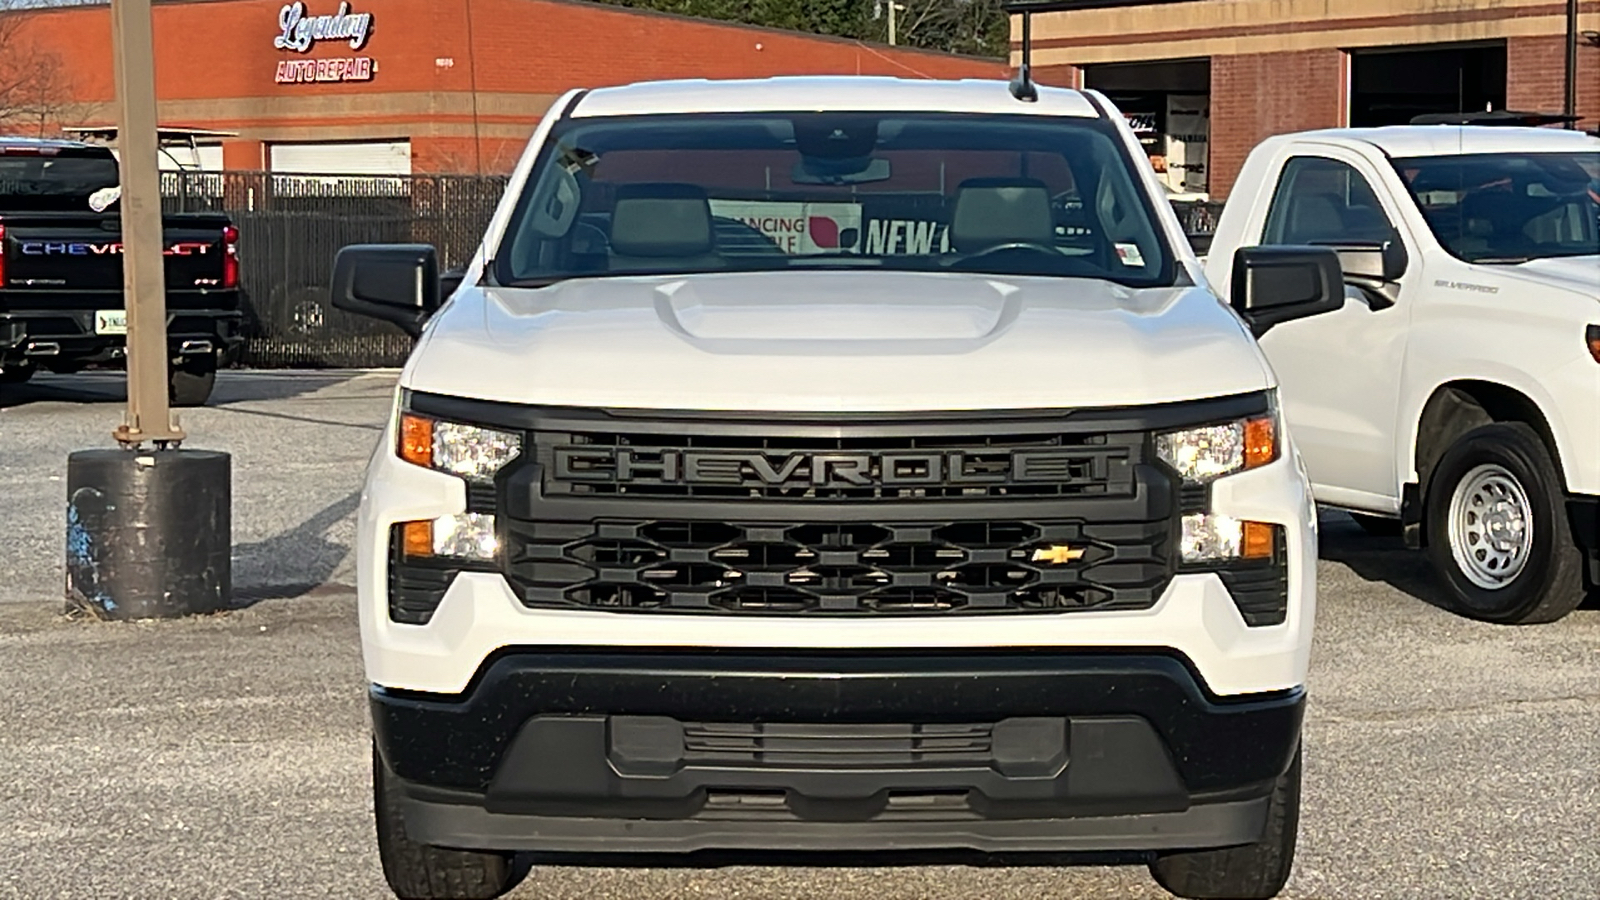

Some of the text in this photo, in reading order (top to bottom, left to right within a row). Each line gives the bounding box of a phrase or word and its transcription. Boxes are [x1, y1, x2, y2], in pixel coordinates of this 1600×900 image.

[274, 1, 371, 52] Legendary
[275, 57, 371, 83] AUTO REPAIR
[552, 446, 1131, 486] CHEVROLET
